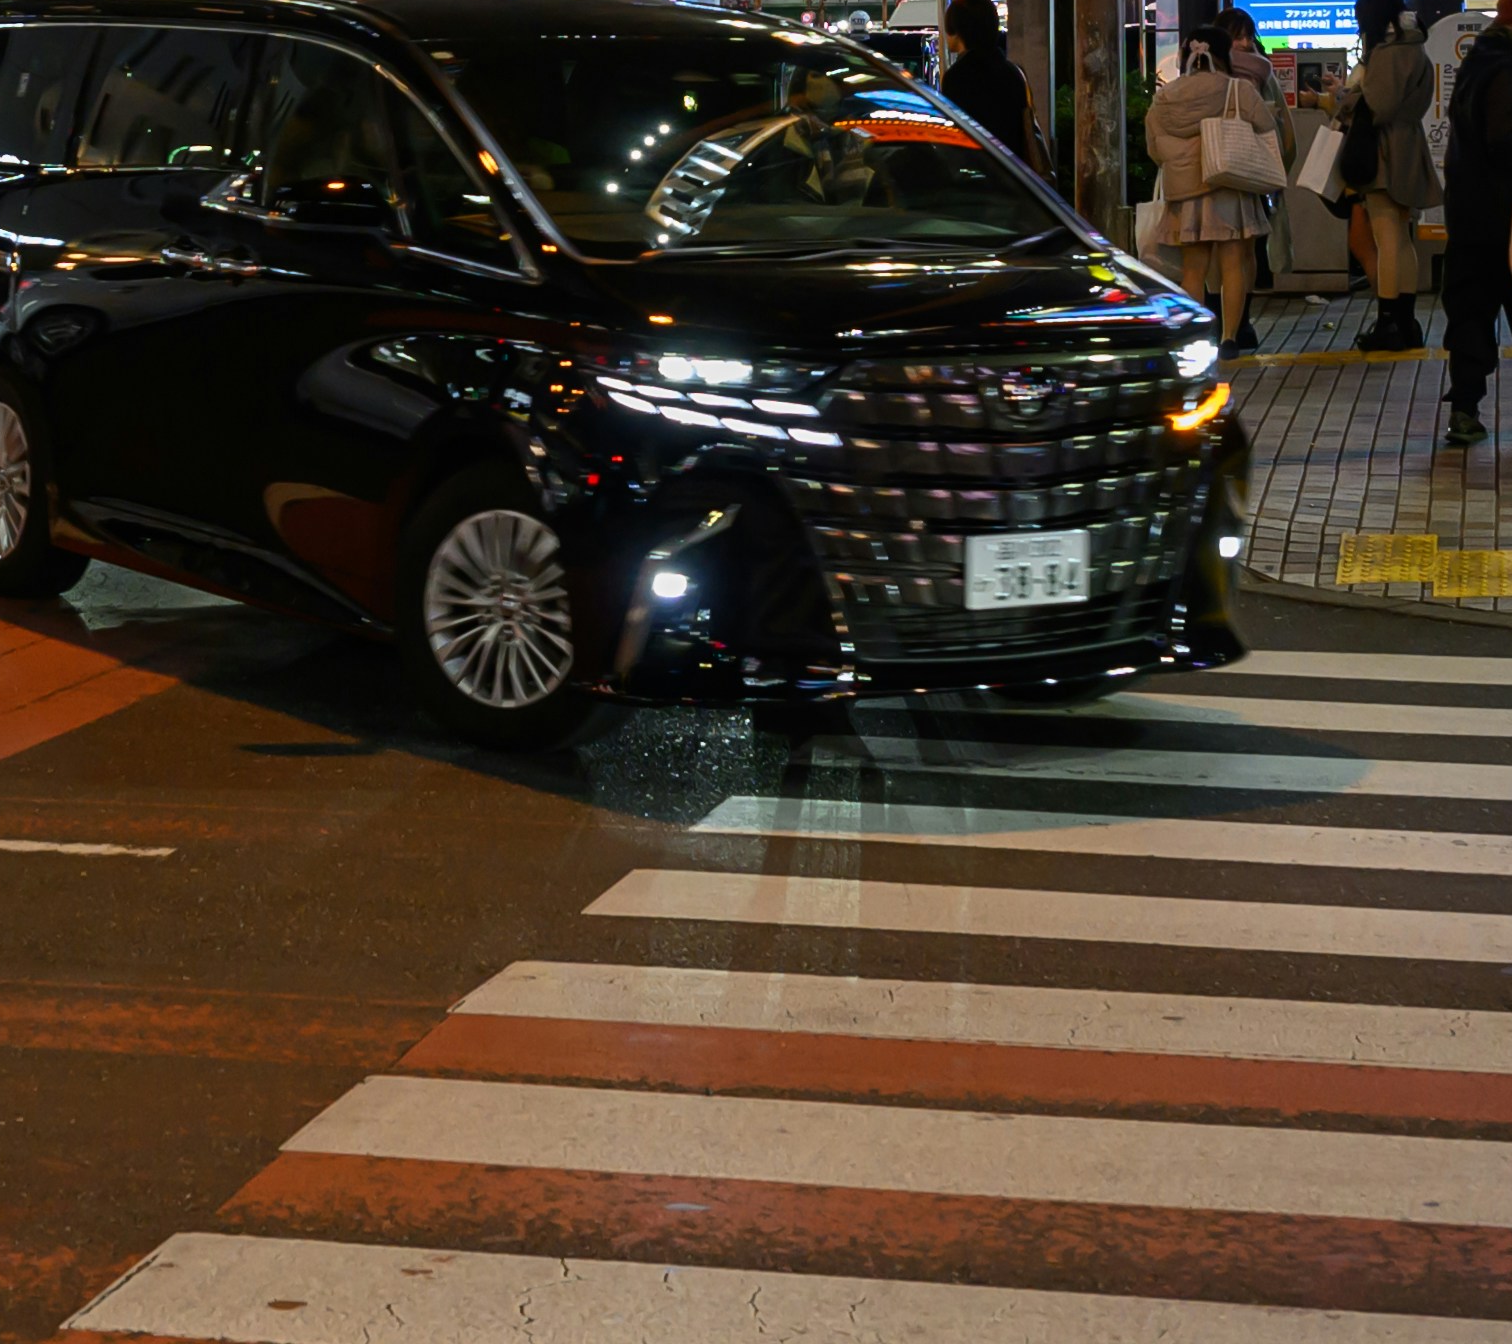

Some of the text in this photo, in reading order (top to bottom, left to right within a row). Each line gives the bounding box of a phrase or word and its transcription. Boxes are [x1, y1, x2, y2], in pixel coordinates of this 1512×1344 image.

[1284, 8, 1331, 18] ファッション
